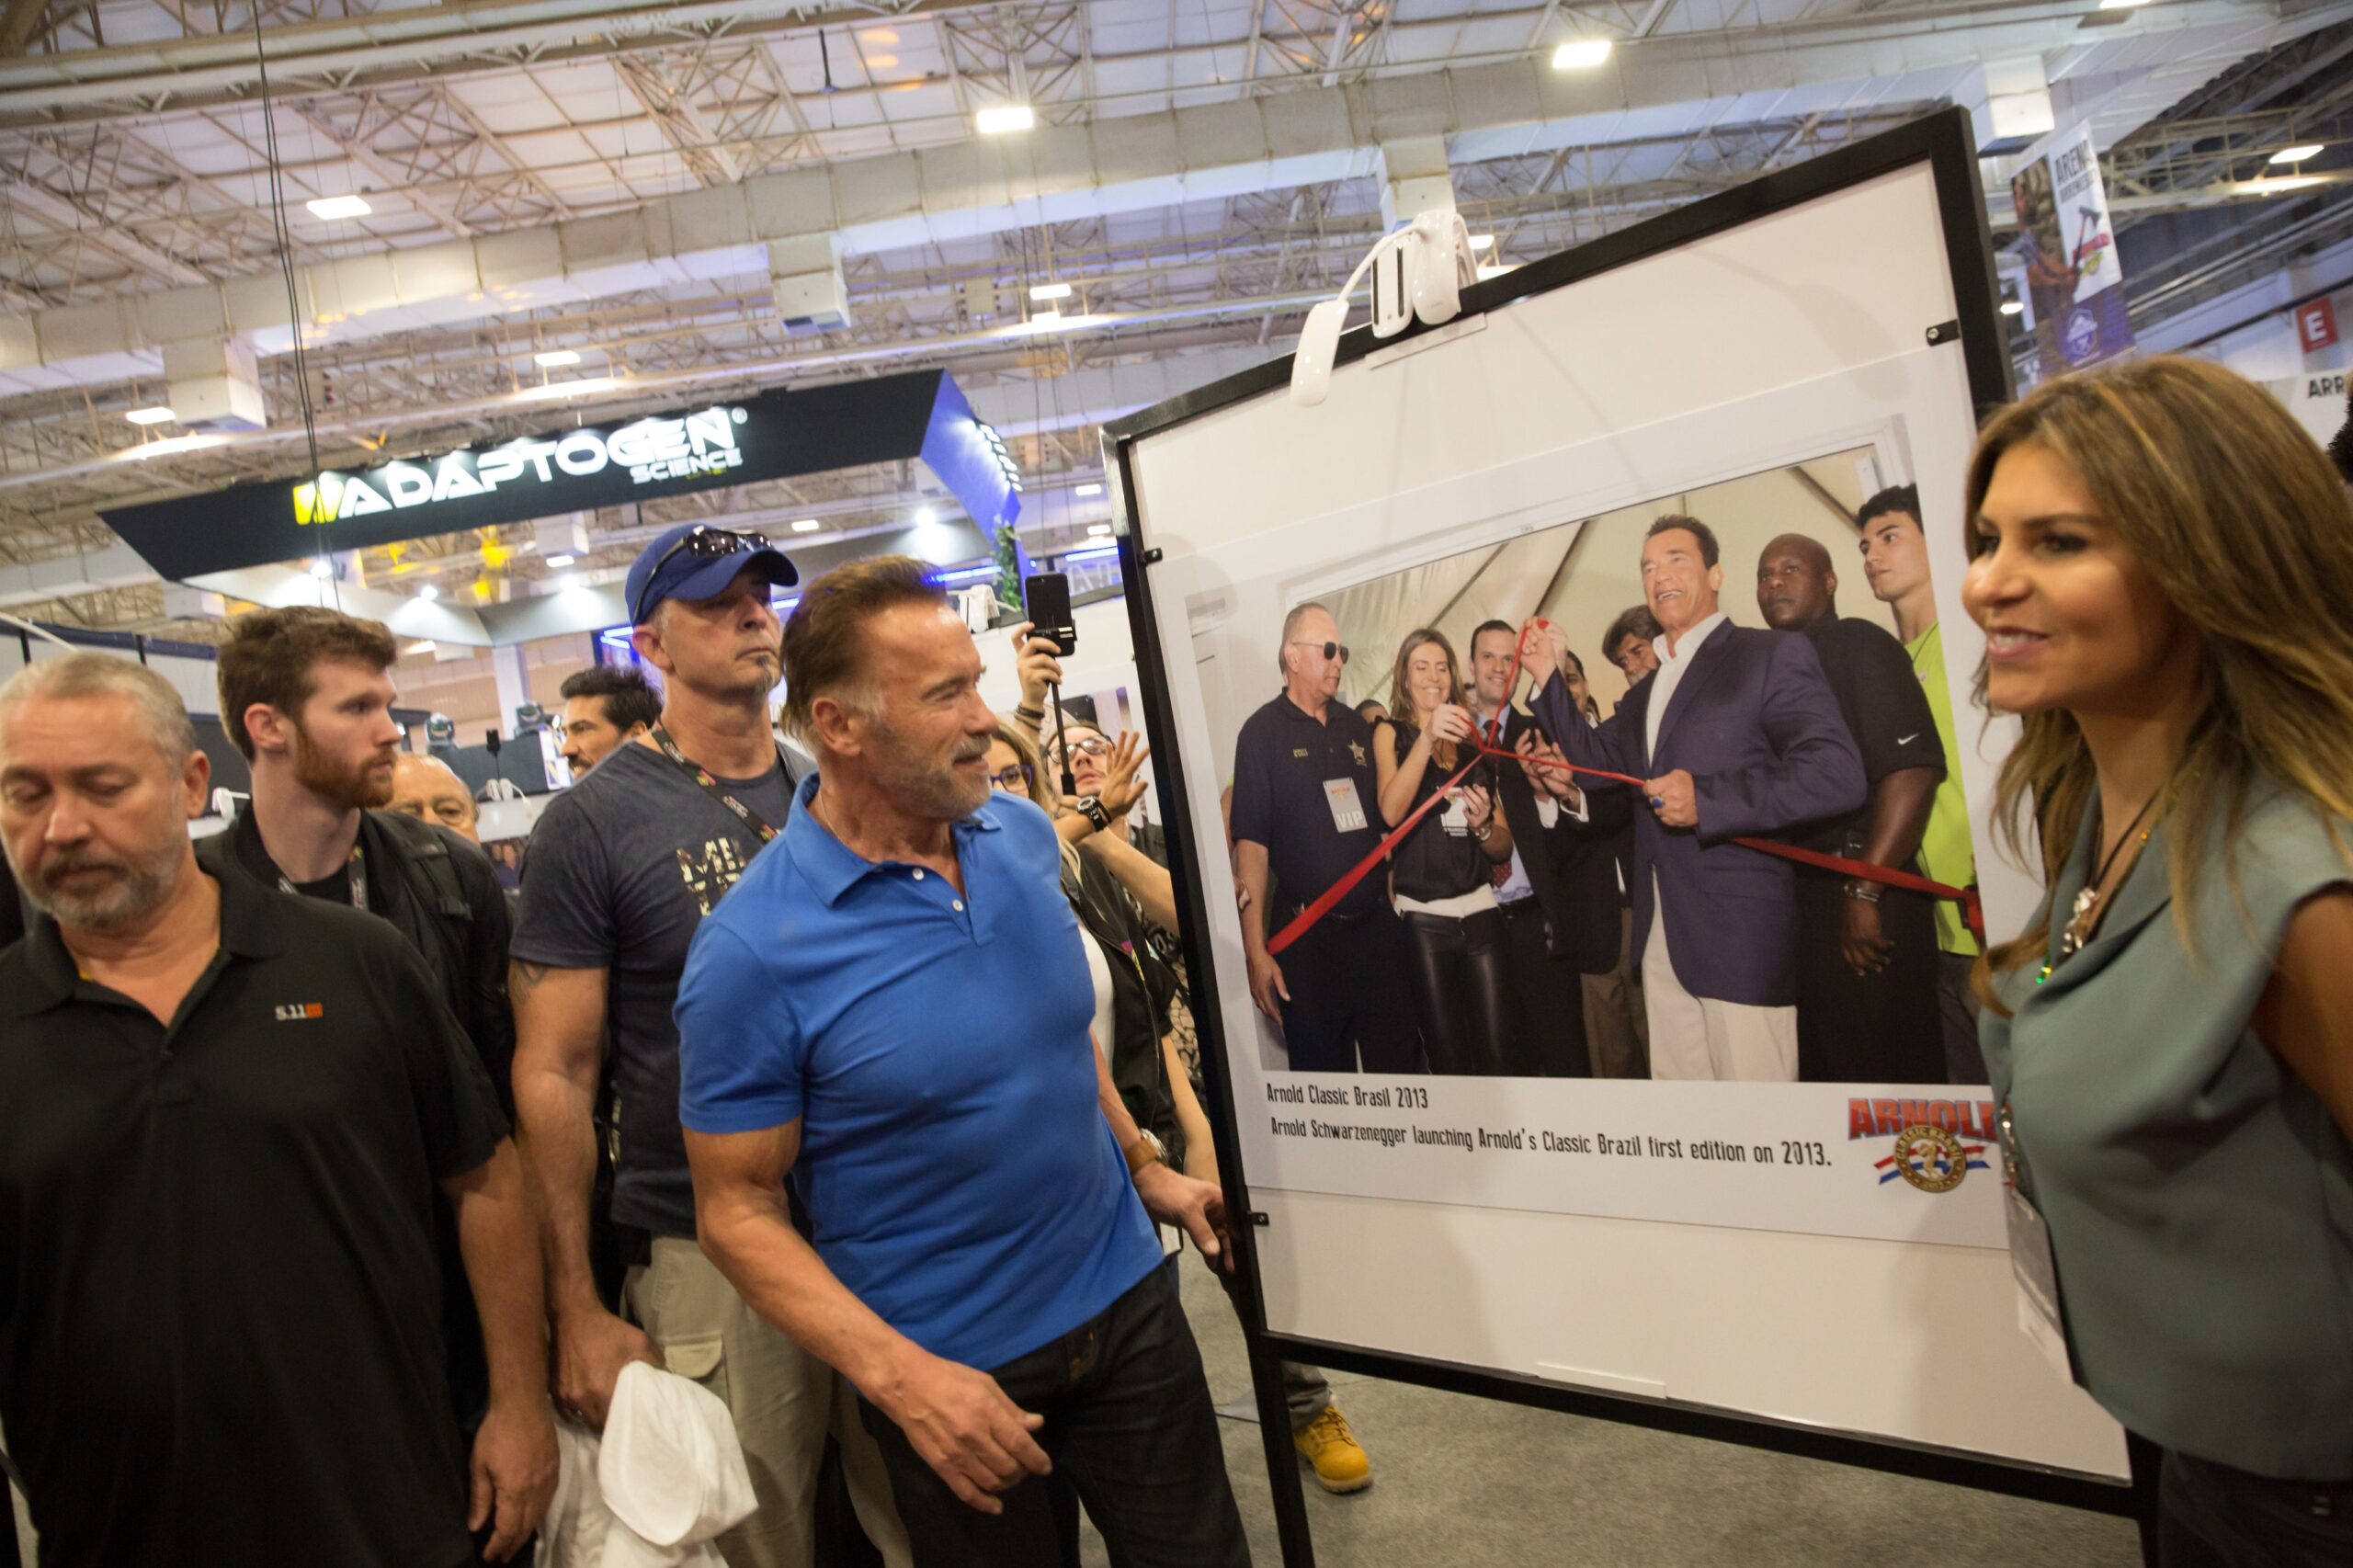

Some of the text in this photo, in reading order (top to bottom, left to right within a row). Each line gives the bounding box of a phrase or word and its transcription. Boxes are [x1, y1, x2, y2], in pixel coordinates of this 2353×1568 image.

[2305, 310, 2327, 341] E
[630, 448, 743, 484] SCIENCE
[1336, 810, 1363, 828] VIP
[1267, 1083, 1428, 1108] Arnold Classic Brasil 2013
[1271, 1117, 1832, 1166] Arnold Schwarzenegger launching Arnold's Classic Brazil first edition on 2013.
